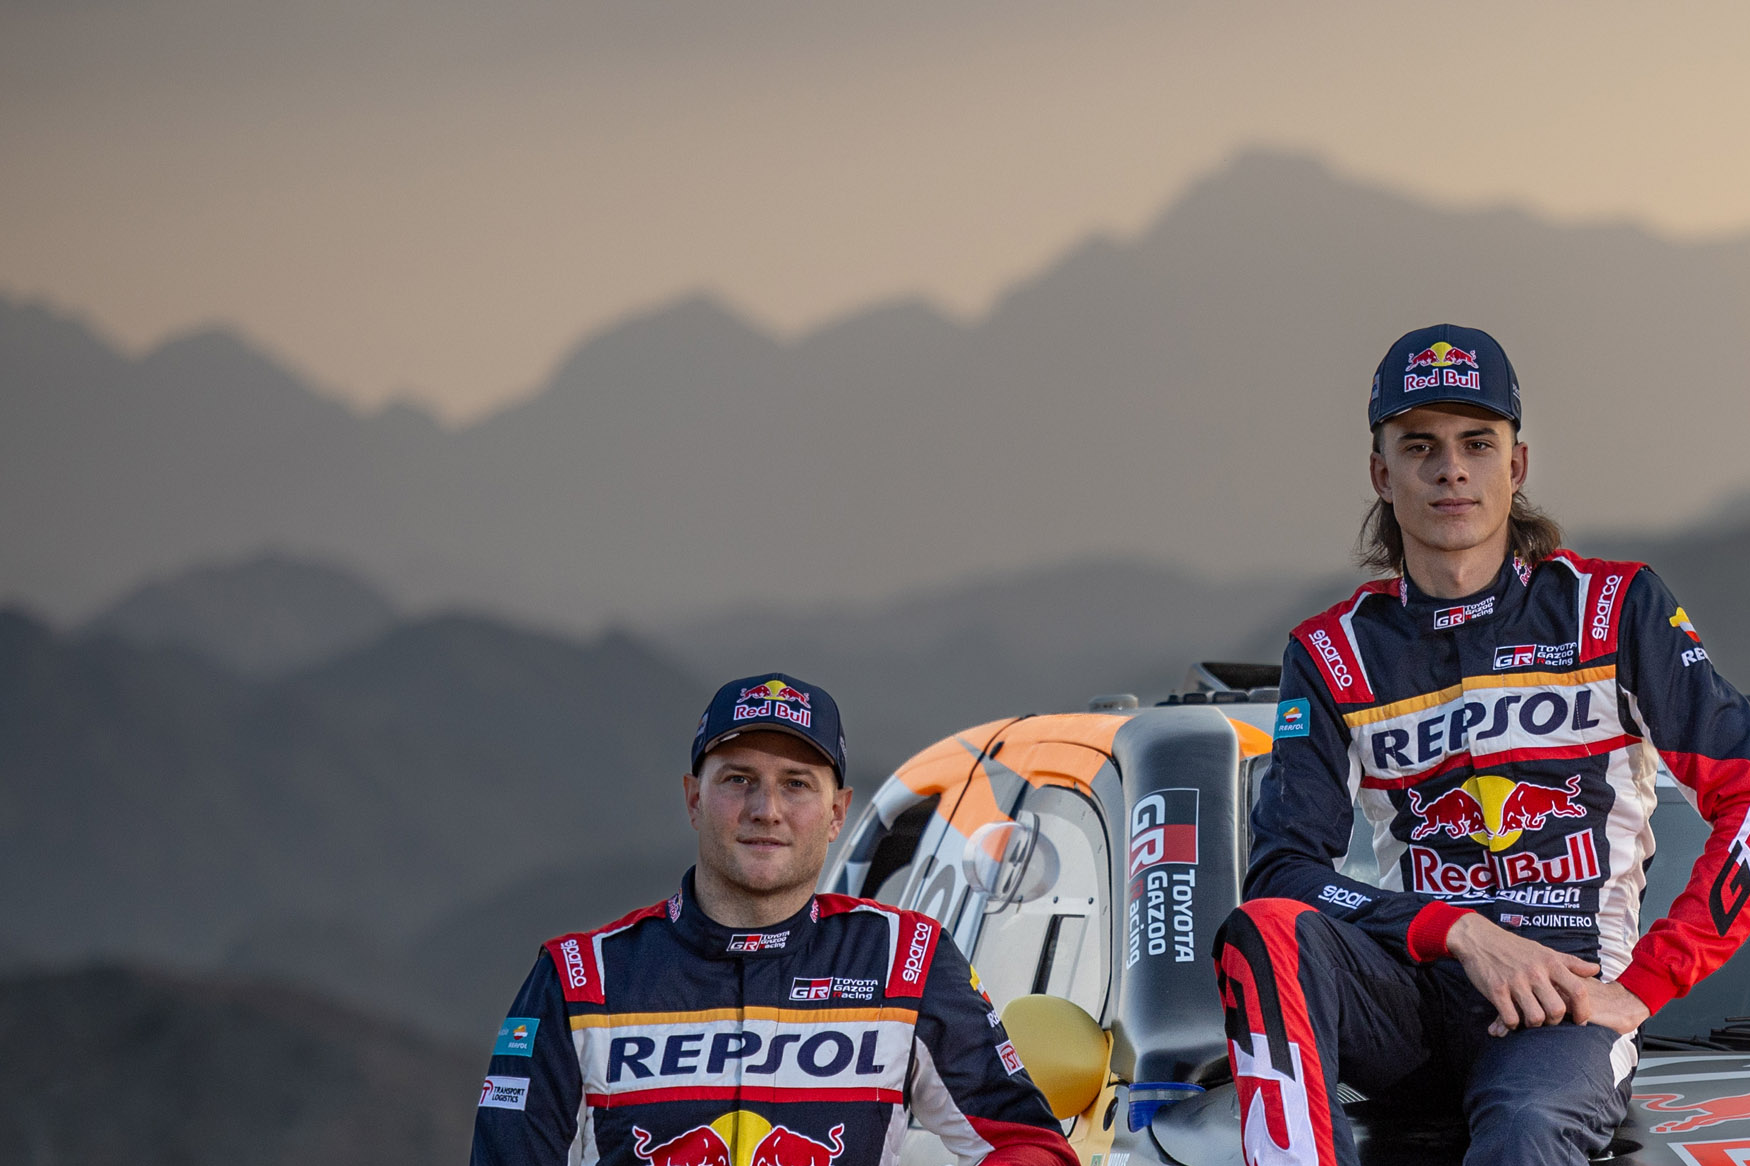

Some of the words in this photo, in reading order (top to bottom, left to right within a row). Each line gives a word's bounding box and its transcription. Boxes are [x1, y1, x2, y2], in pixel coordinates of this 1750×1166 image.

[1404, 368, 1439, 392] Red
[1443, 369, 1480, 390] Bull
[1465, 595, 1495, 610] TOYOTA
[1465, 602, 1493, 615] GAZOO
[1465, 608, 1493, 620] Racing
[1592, 575, 1623, 641] sparco
[1537, 650, 1574, 659] GAZOO
[1538, 642, 1577, 652] TOYOTA
[1308, 629, 1353, 691] sparco
[1536, 657, 1573, 666] Racing
[733, 700, 772, 720] Red
[775, 701, 812, 728] Bull
[1371, 690, 1600, 771] REPSOL
[1130, 795, 1167, 877] GR
[1409, 844, 1500, 895] Red
[1502, 828, 1601, 888] Bull
[1318, 884, 1372, 909] spar
[1126, 877, 1145, 970] Racing
[1147, 871, 1167, 956] GAZOO
[1173, 869, 1196, 963] TOYOTA
[1522, 915, 1592, 928] S.QUINTERO
[561, 939, 587, 989] sparco
[903, 922, 932, 984] sparco
[833, 985, 874, 993] GAZOO
[834, 977, 878, 986] TOYOTA
[833, 991, 873, 1000] Racing
[606, 1030, 886, 1083] REPSOL
[492, 1093, 518, 1103] LOGISTICS
[494, 1086, 525, 1096] TRANSPORT
